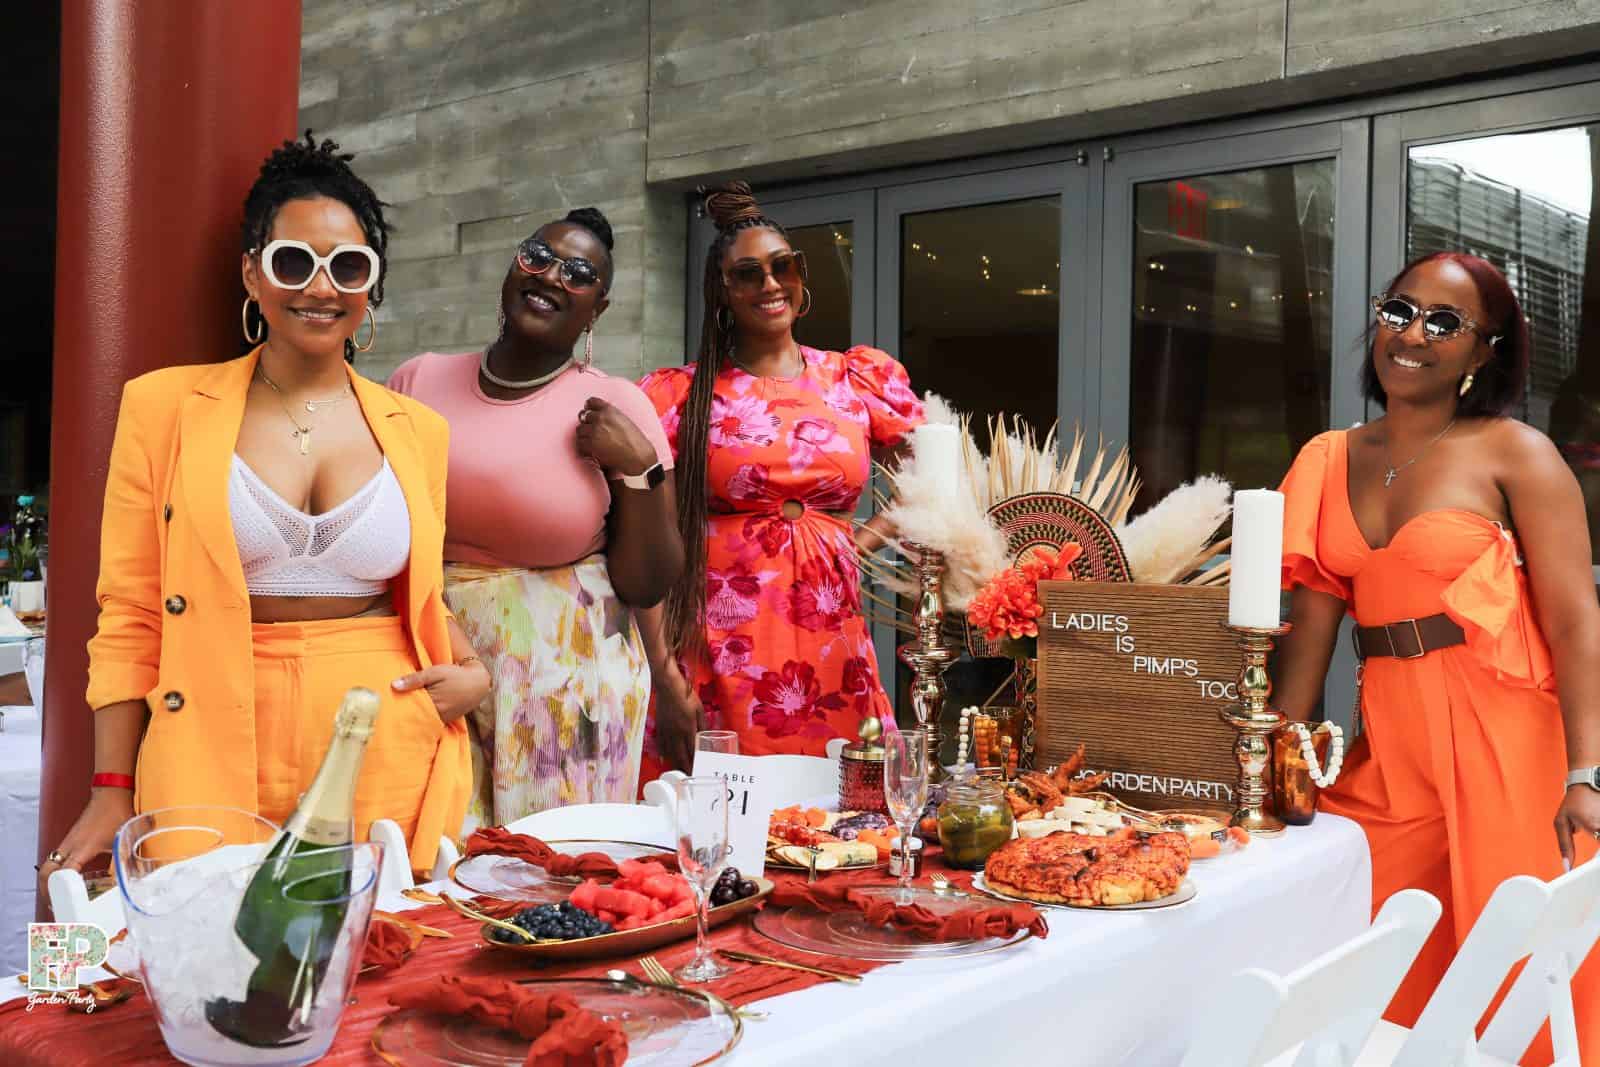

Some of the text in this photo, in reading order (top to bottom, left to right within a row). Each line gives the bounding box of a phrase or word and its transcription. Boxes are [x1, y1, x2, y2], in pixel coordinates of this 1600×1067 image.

[1052, 612, 1129, 632] LADIES
[1116, 636, 1135, 653] IS
[1133, 656, 1198, 677] PIMPS
